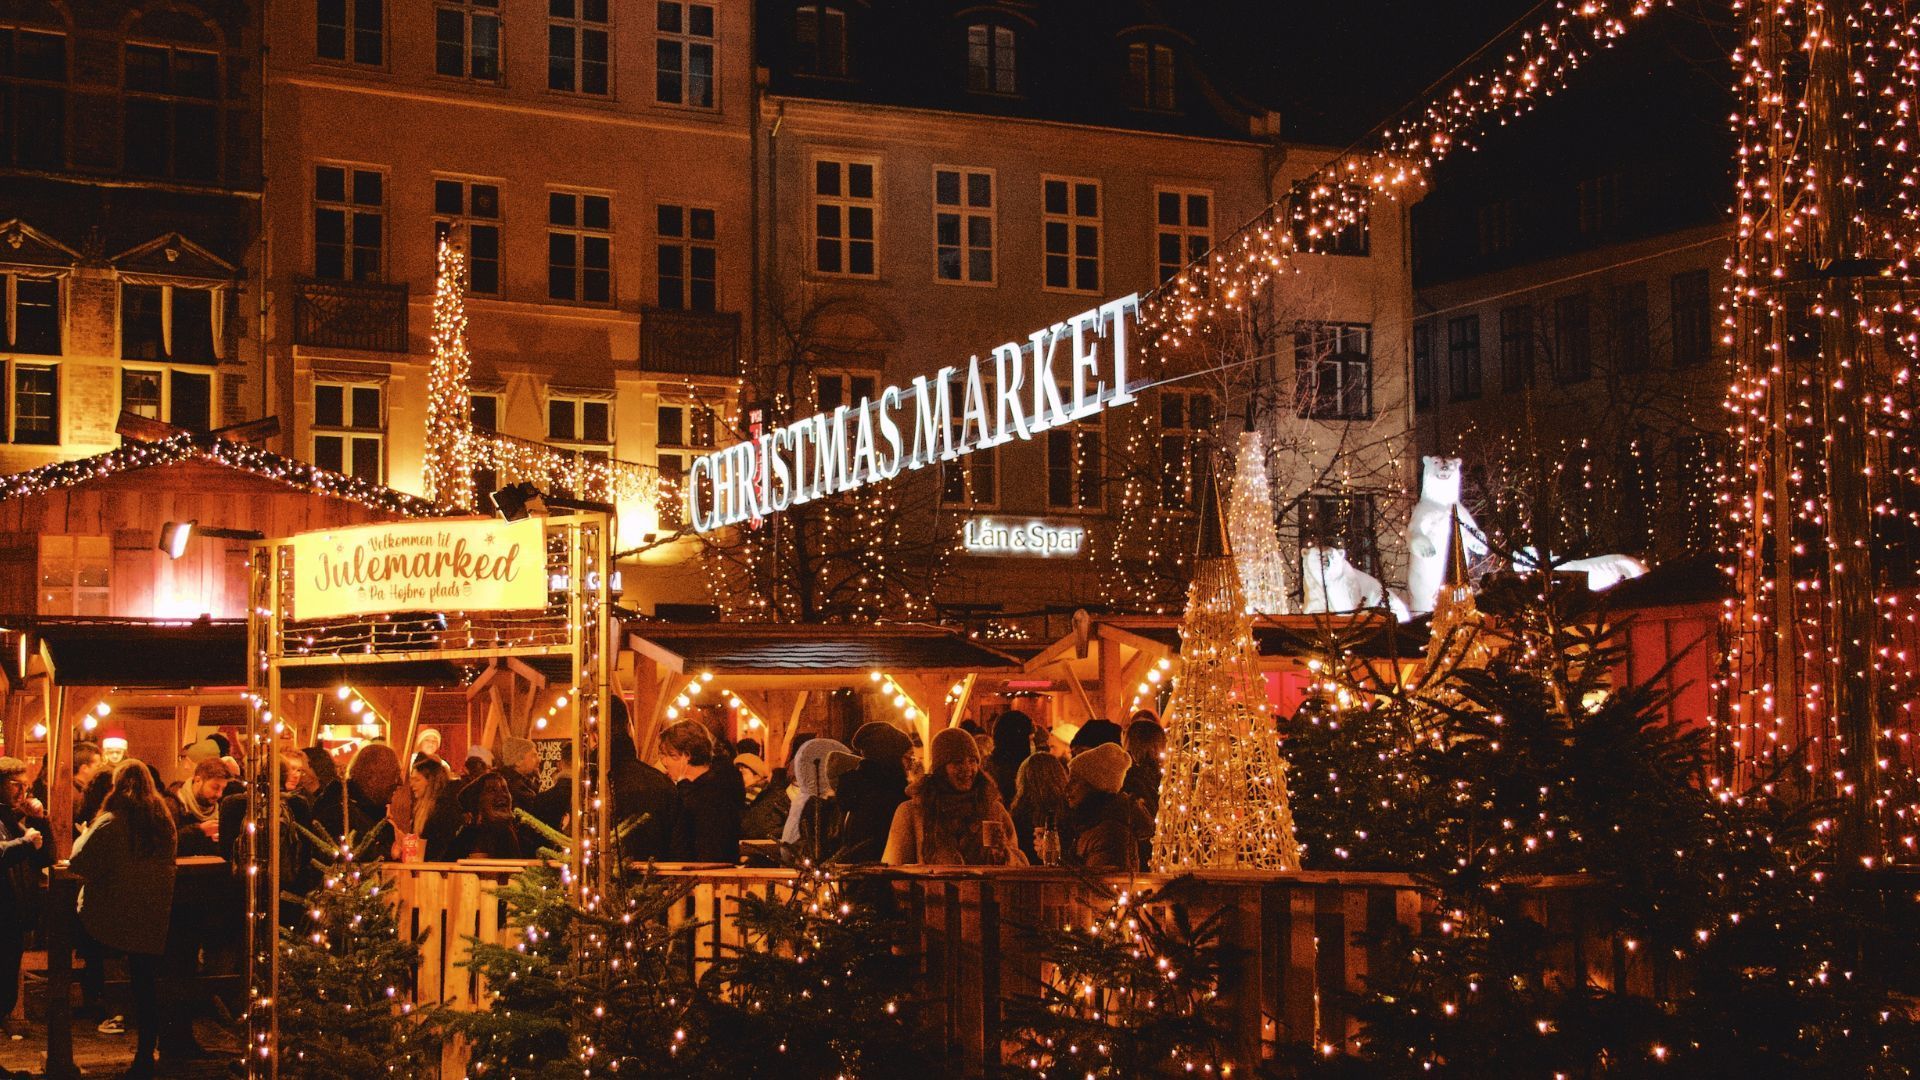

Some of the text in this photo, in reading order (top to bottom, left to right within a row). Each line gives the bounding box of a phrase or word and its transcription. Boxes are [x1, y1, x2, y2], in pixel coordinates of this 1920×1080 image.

[689, 385, 902, 533] CHRISTMAS
[908, 292, 1140, 470] MARKET
[367, 531, 451, 552] Velkommen til
[314, 537, 521, 592] Julemarked
[429, 580, 460, 604] plads
[537, 741, 562, 752] DANSK
